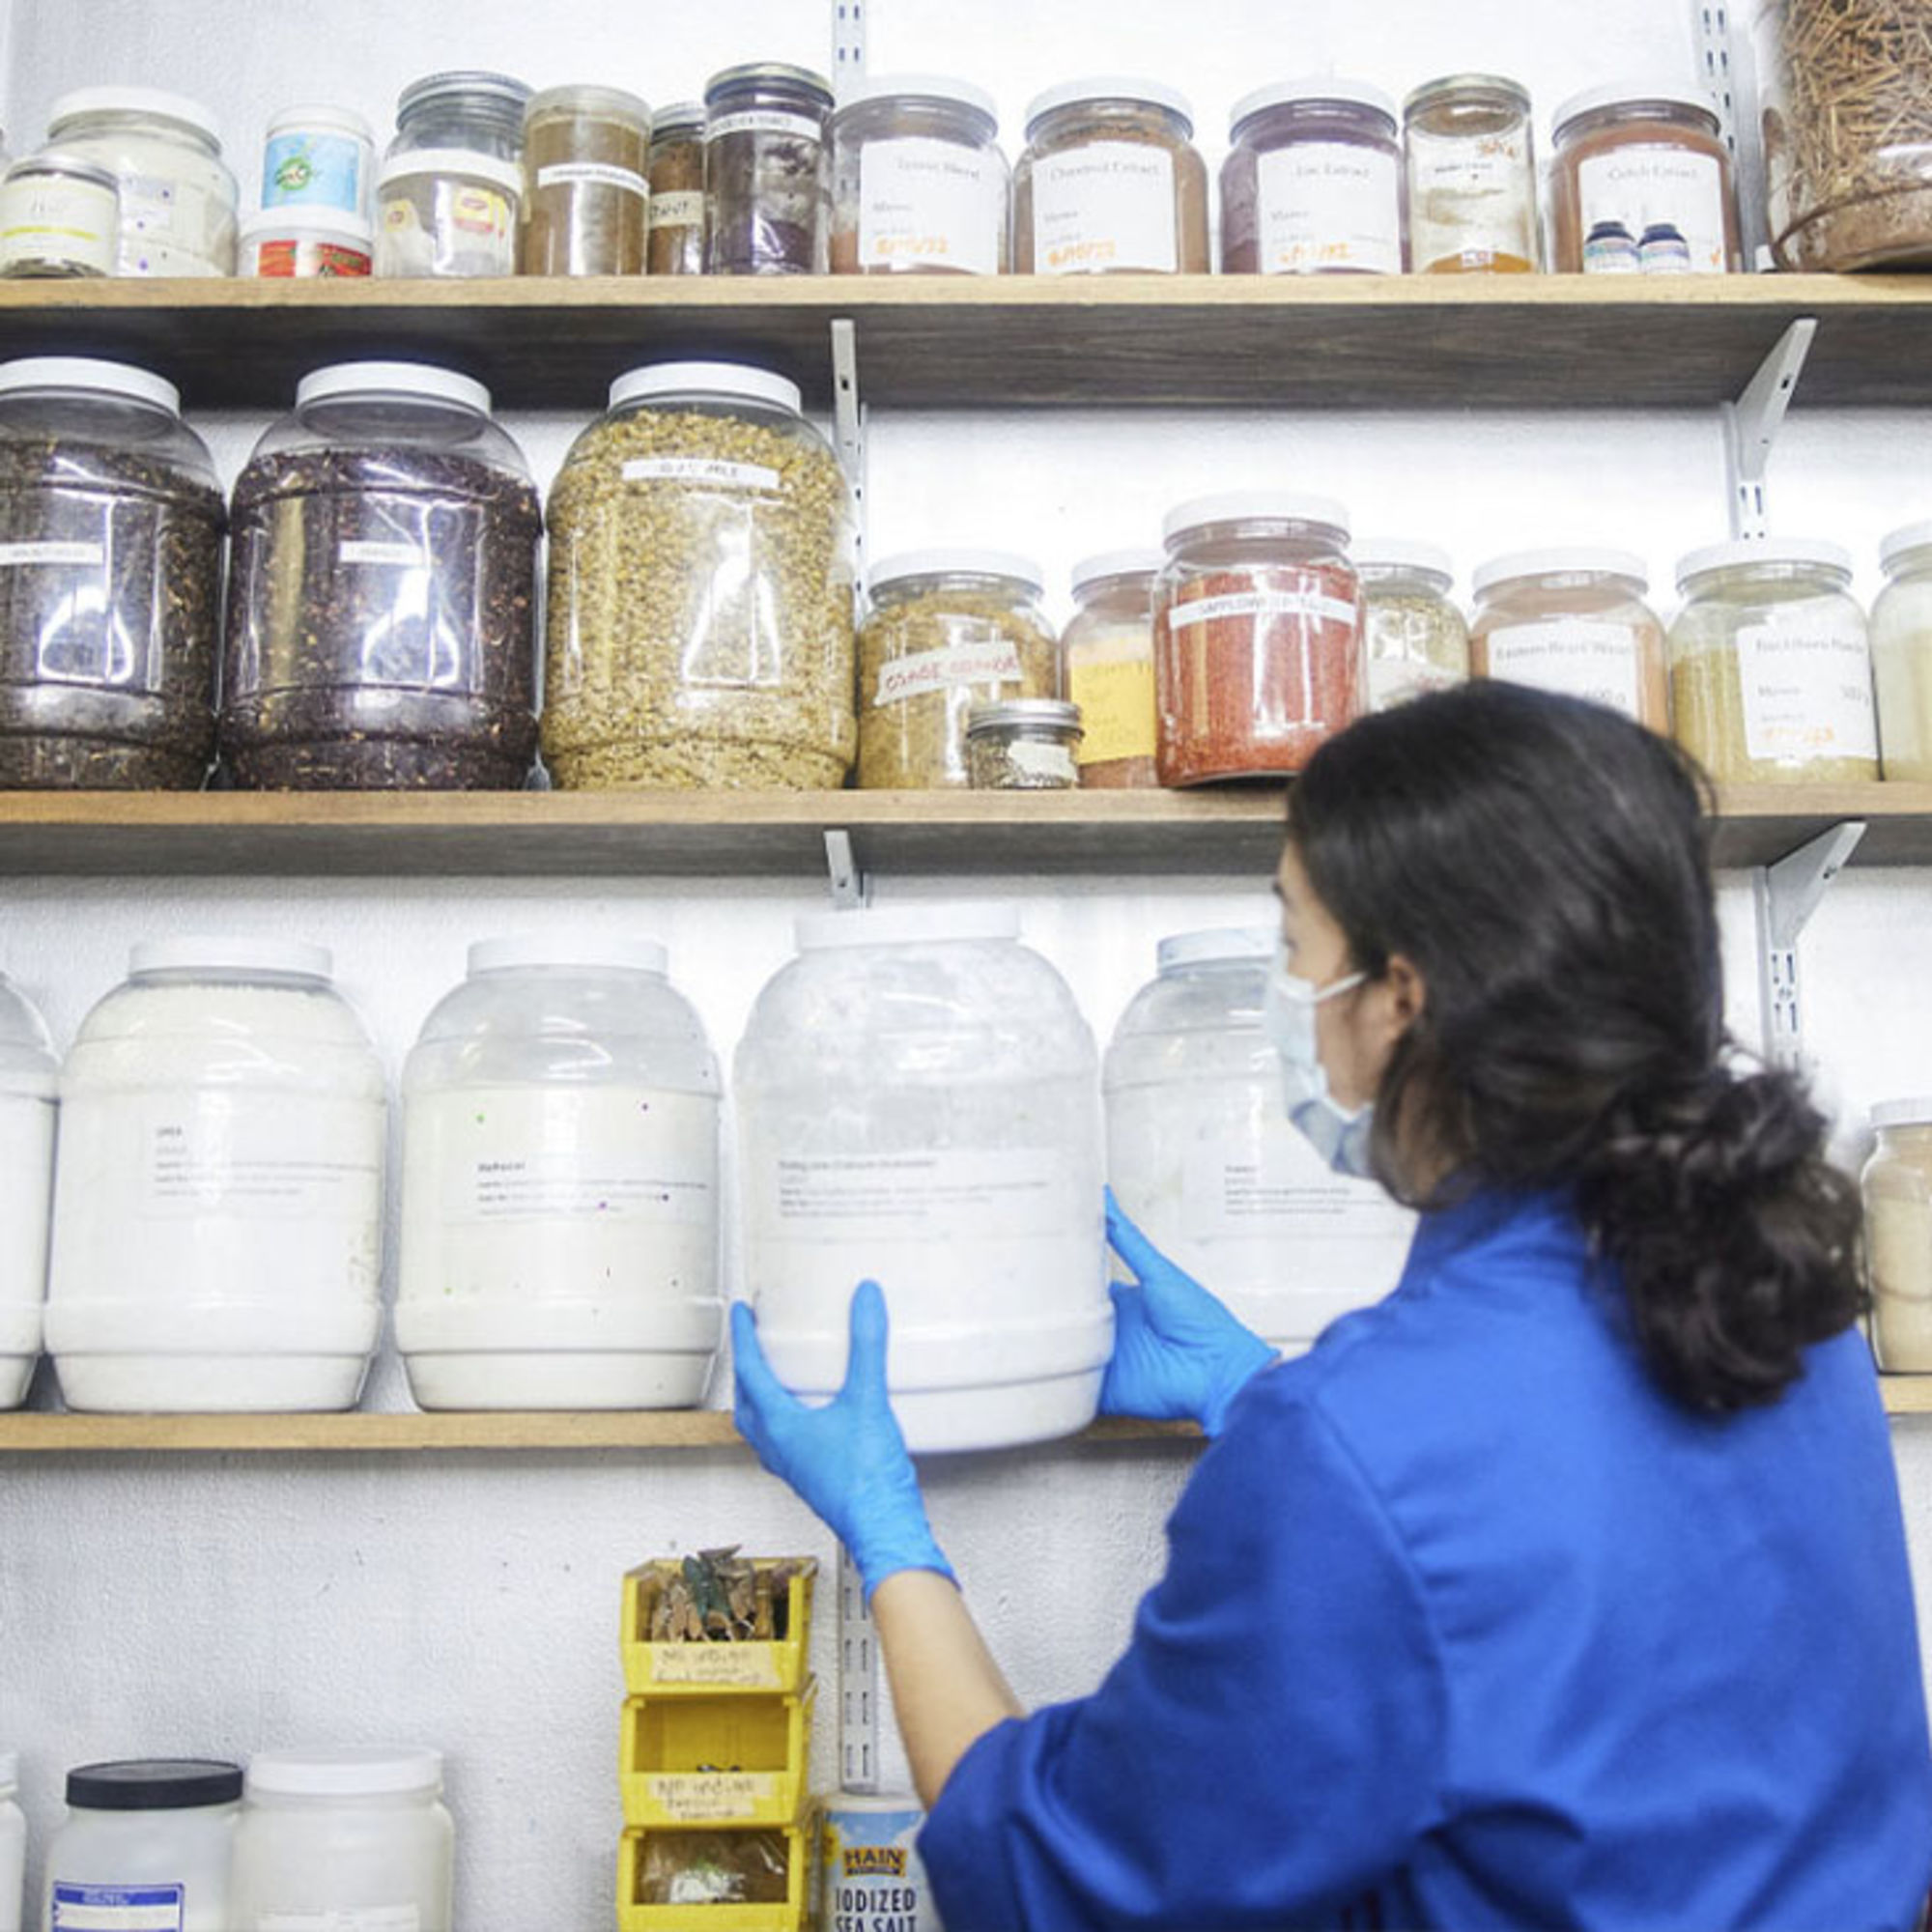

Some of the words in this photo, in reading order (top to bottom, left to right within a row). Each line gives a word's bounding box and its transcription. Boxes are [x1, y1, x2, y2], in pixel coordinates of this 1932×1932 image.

[843, 1846, 904, 1868] HAIN
[835, 1887, 918, 1914] IODIZED
[835, 1915, 866, 1932] SEA
[871, 1915, 918, 1932] SALT
